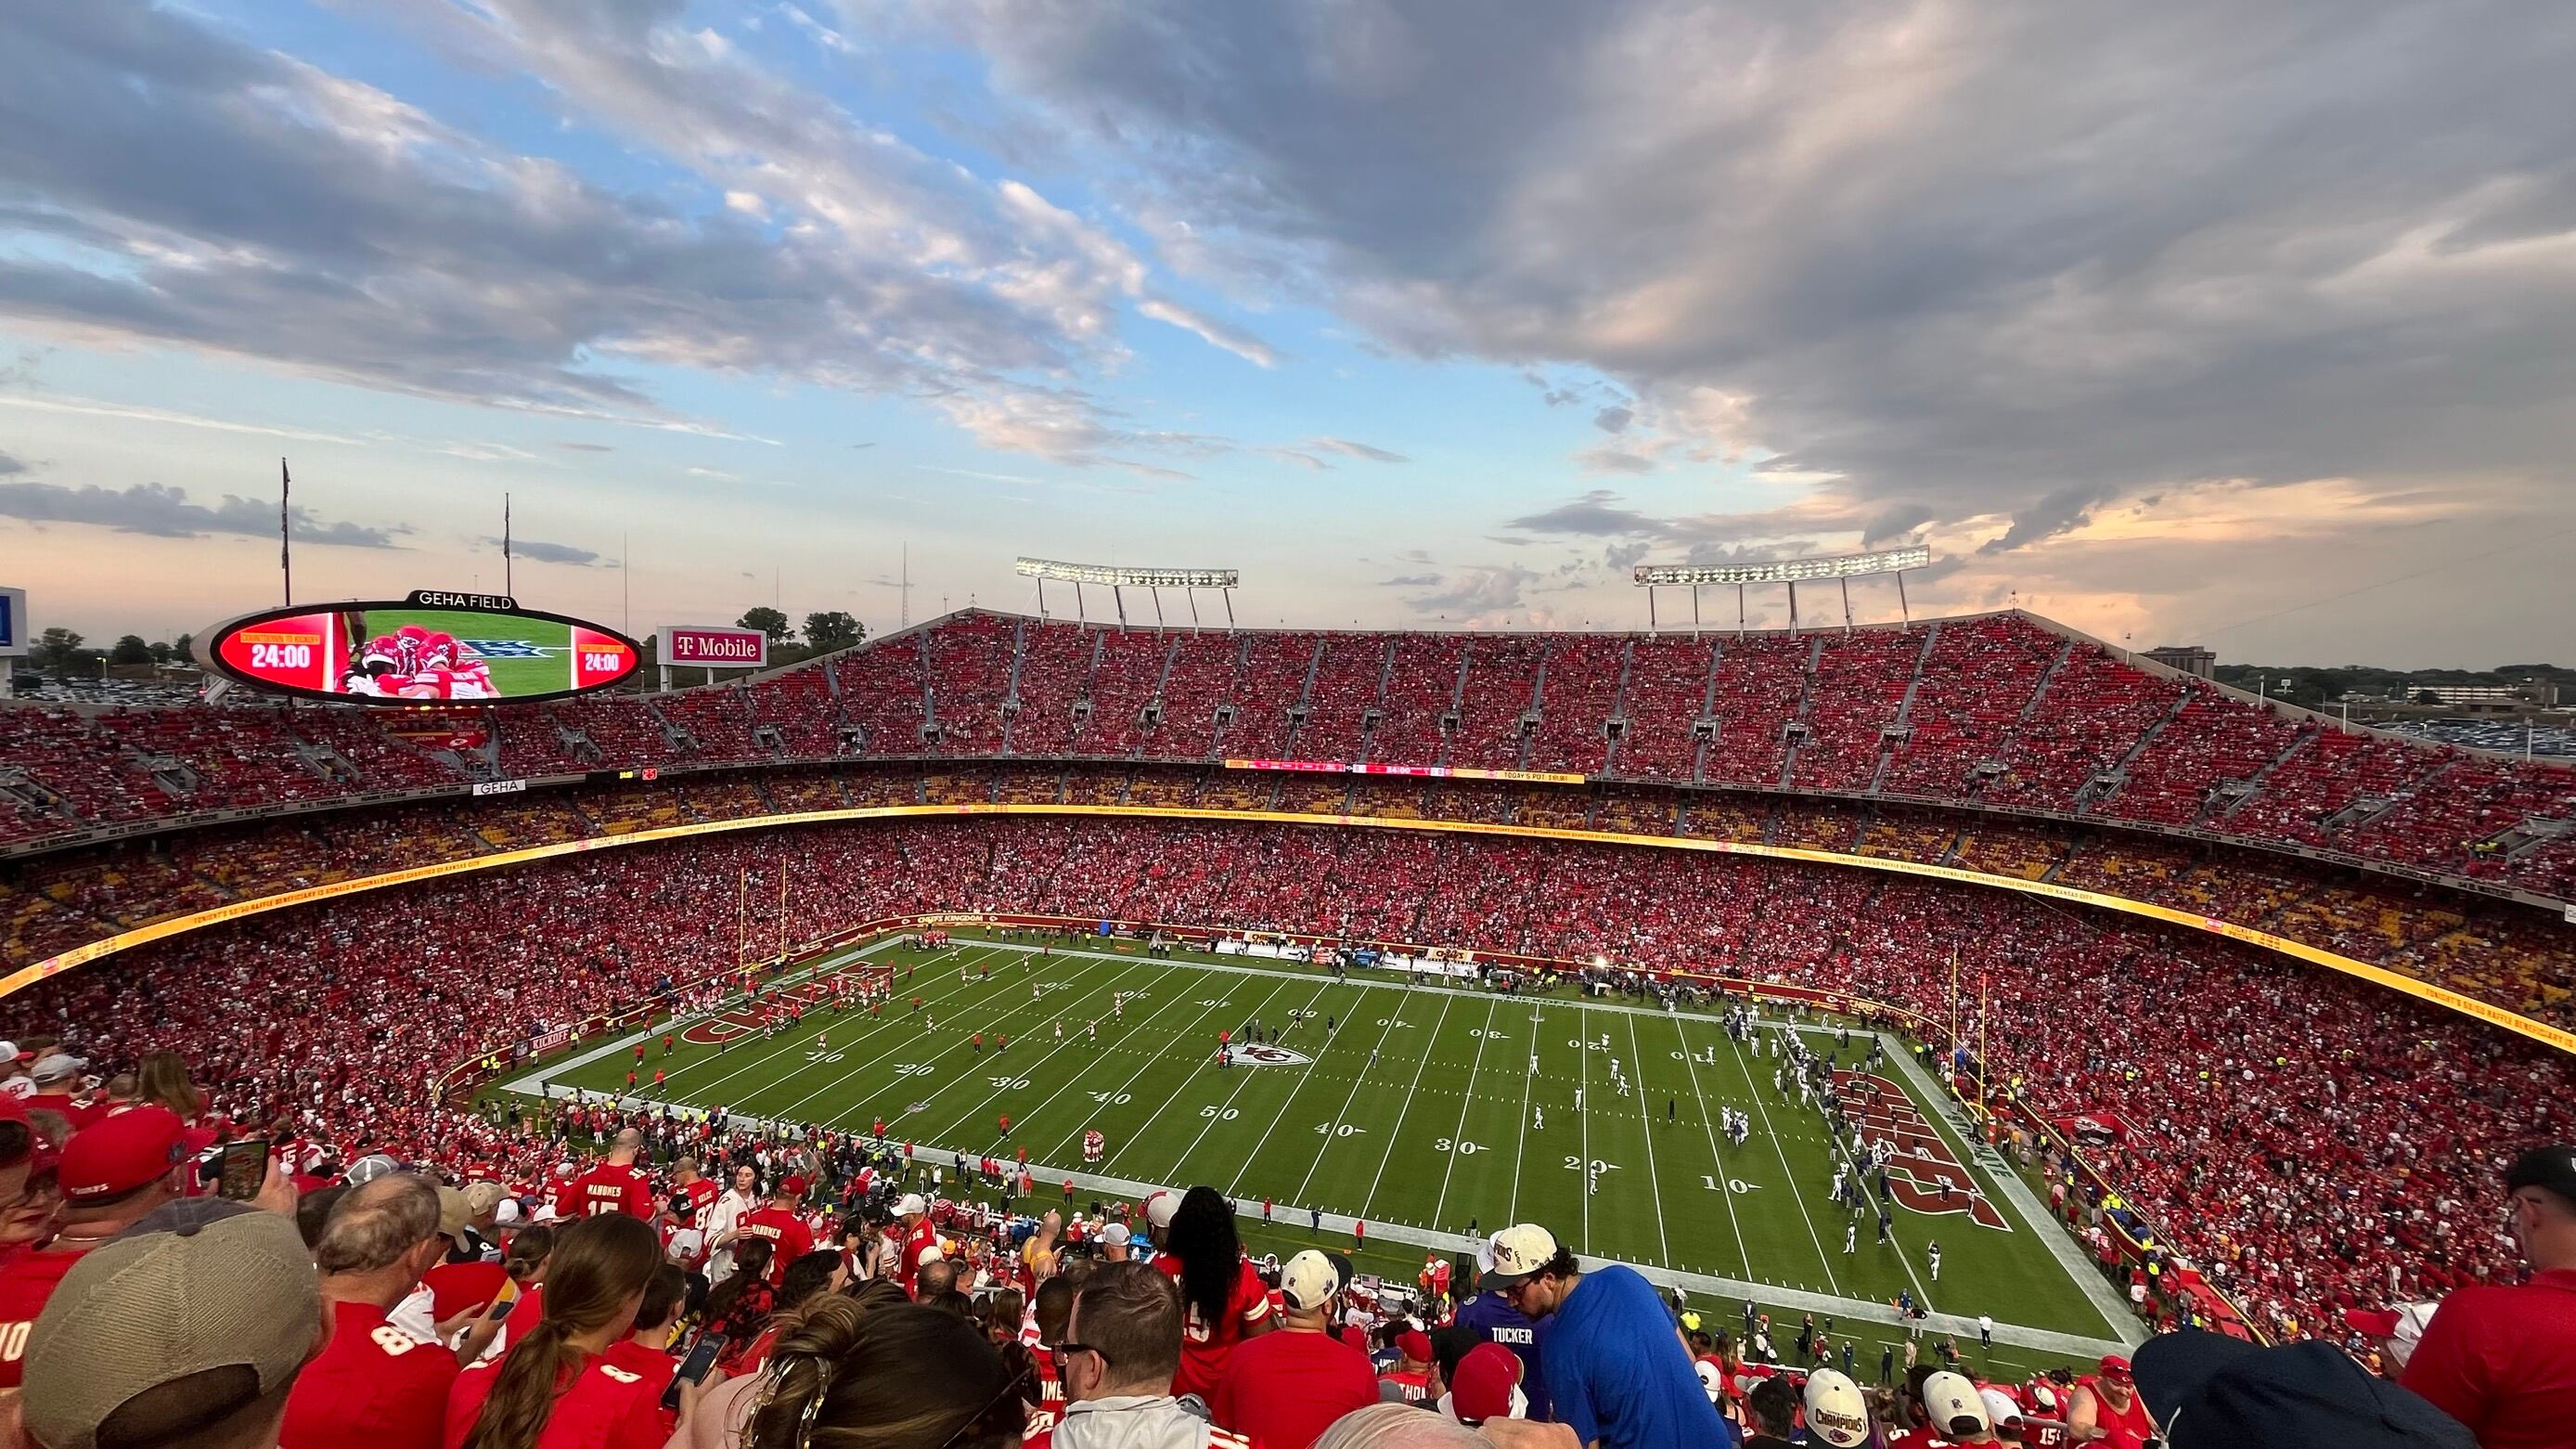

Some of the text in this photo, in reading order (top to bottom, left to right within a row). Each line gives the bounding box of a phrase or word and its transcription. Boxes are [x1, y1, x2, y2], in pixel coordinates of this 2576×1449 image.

[419, 591, 512, 610] GEHA FIELD
[251, 643, 311, 668] 24:00
[677, 636, 757, 658] T Mobile
[585, 653, 619, 672] 24:00
[480, 780, 519, 795] GEHA
[2135, 823, 2166, 833] HOLMES
[2252, 840, 2300, 855] RICHARDSON
[2333, 854, 2364, 867] CARSON
[2487, 1009, 2512, 1026] RAFFLE
[2515, 1019, 2563, 1043] BENEFICIARY
[532, 1029, 570, 1049] KICKOFF
[895, 1063, 935, 1077] 20
[991, 1076, 1031, 1091] 30
[1093, 1090, 1132, 1106] 40
[1199, 1105, 1240, 1121] 50
[1313, 1121, 1357, 1137] 40
[1434, 1138, 1477, 1156] 30
[281, 1149, 297, 1163] 15
[1563, 1156, 1608, 1174] 20
[586, 1184, 622, 1197] MAHOMES
[1699, 1174, 1749, 1195] 10
[695, 1202, 715, 1231] 87
[752, 1223, 782, 1240] MAHOMES
[1491, 1326, 1533, 1345] TUCKER
[1815, 1407, 1862, 1433] CHAMPIONS
[2040, 1428, 2057, 1445] 15
